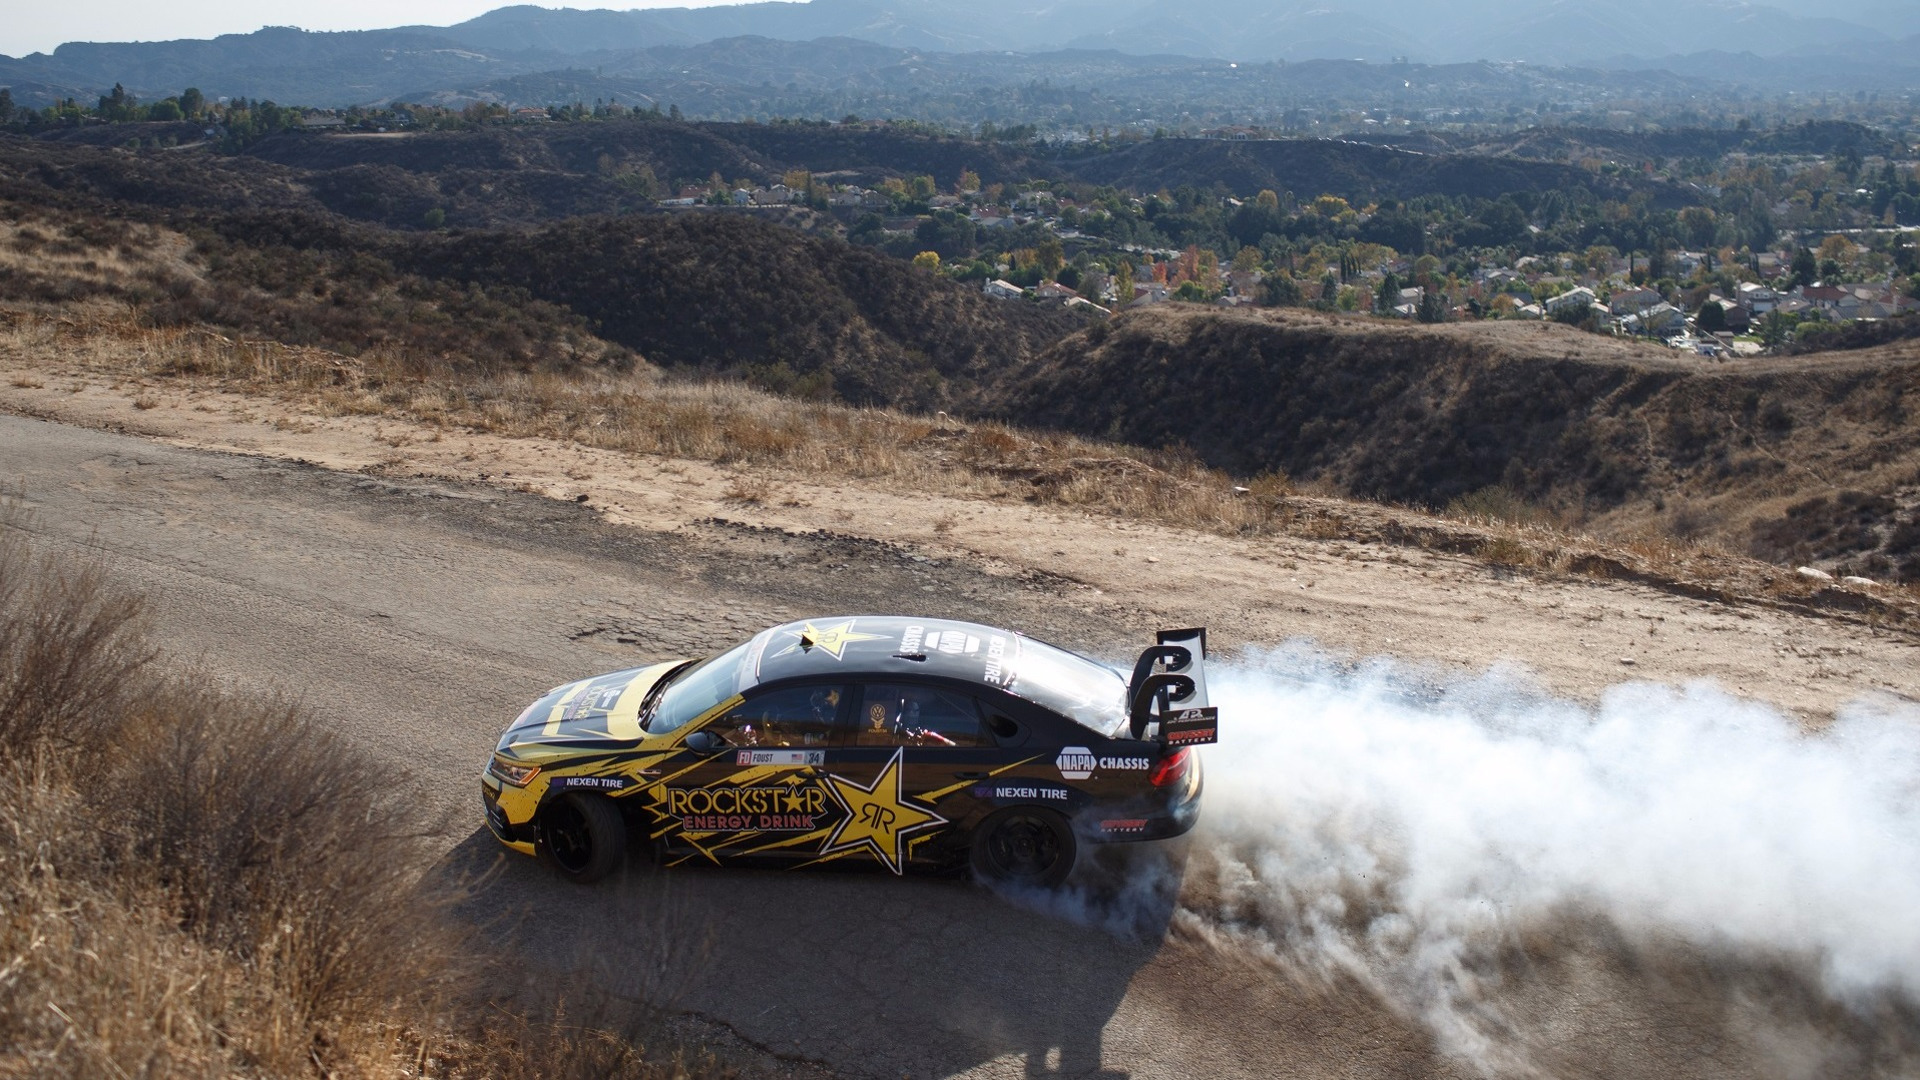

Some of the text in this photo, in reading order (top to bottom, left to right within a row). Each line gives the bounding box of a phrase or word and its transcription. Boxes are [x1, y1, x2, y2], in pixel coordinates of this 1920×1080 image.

[984, 660, 1002, 684] TIRE
[1168, 737, 1213, 745] BATTERY
[752, 753, 774, 763] FOUST
[808, 753, 820, 764] 34
[1062, 755, 1090, 771] NAPA
[1099, 757, 1150, 770] CHASSIS
[566, 777, 623, 788] NEXEN TIRE
[996, 787, 1068, 800] NEXEN TIRE
[670, 787, 825, 814] ROCKSTAR
[684, 814, 814, 829] ENERGY DRINK
